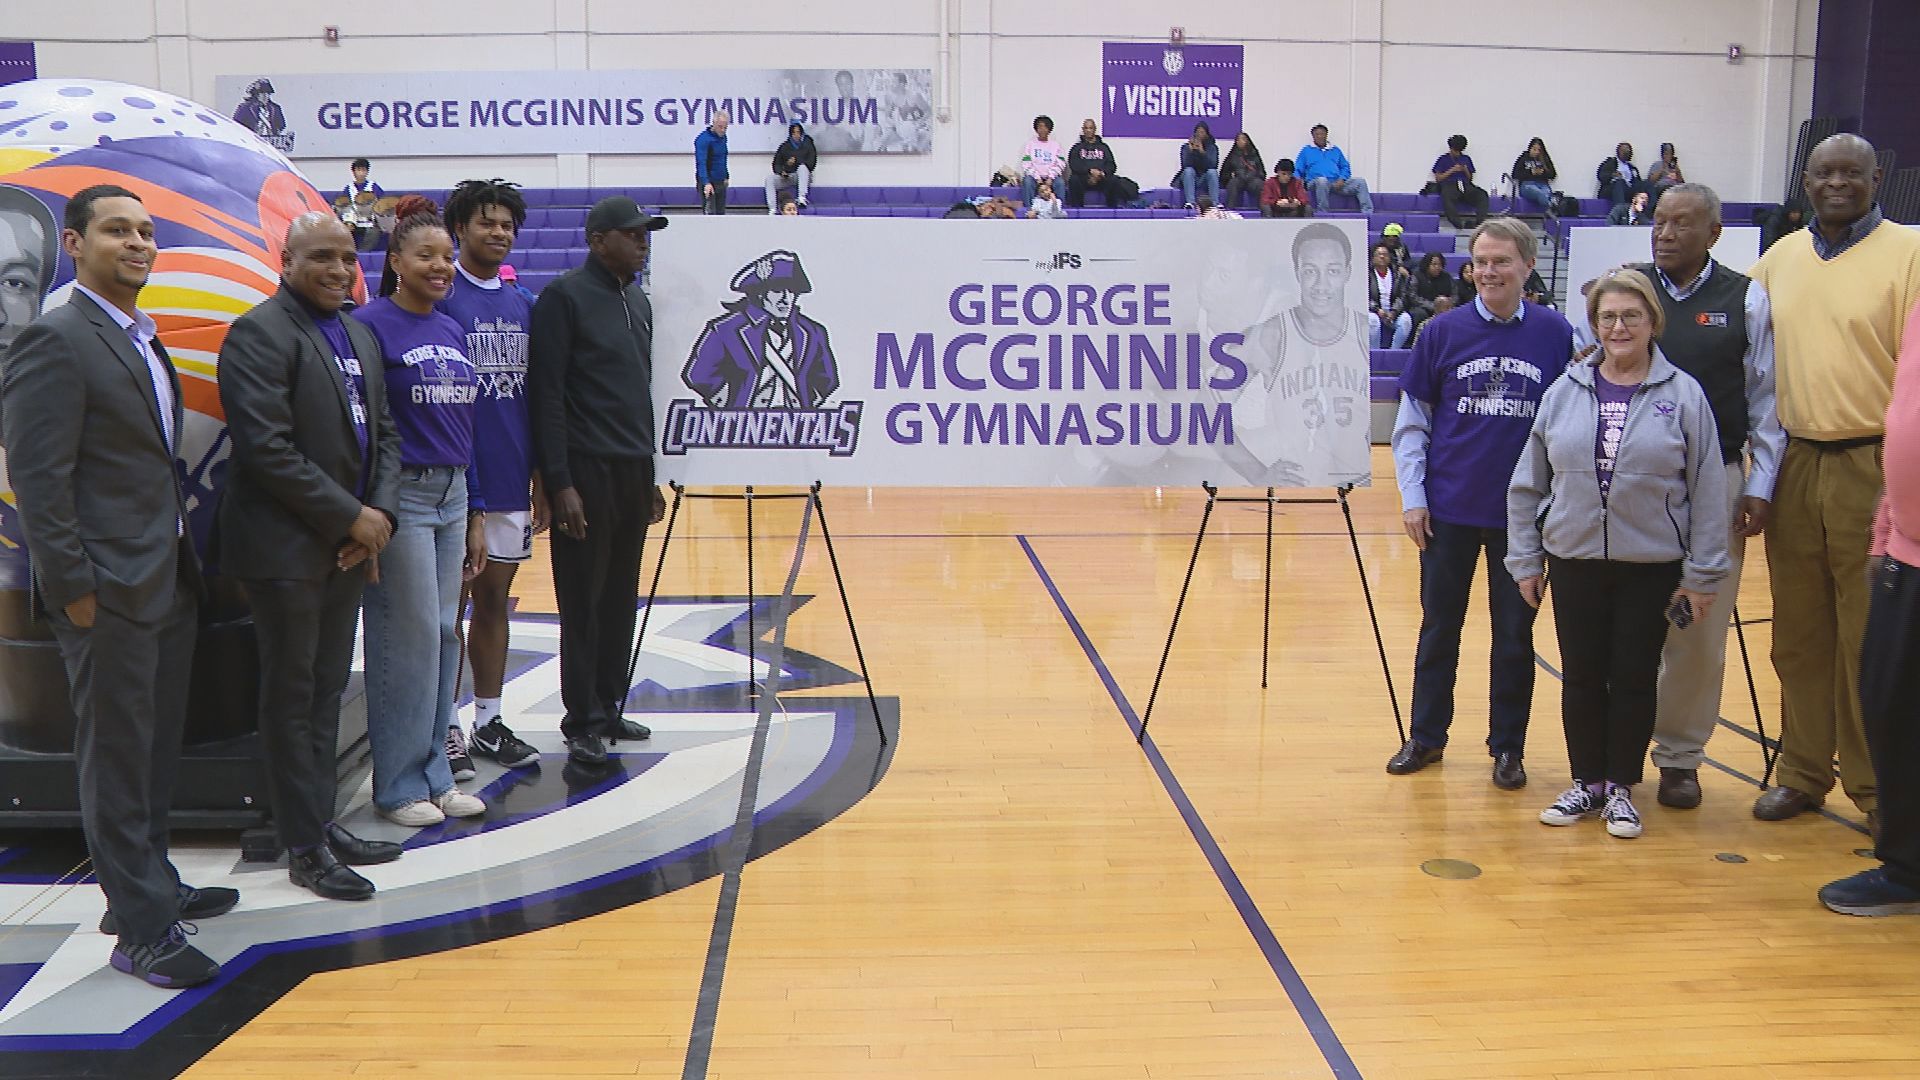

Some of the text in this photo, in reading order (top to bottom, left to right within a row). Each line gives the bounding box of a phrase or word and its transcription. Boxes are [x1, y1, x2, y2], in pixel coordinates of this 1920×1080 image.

[317, 97, 879, 130] GEORGE MCGINNIS GYMNASIUM
[1124, 84, 1221, 116] VISITORS
[948, 282, 1172, 326] GEORGE
[873, 332, 1249, 392] MCGINNIS
[1457, 356, 1499, 380] GEORGE
[885, 402, 1235, 446] GYMNASIUM
[1302, 396, 1354, 430] 35
[1456, 396, 1536, 418] GYMNASIUM
[662, 399, 864, 456] CONTINENTALS
